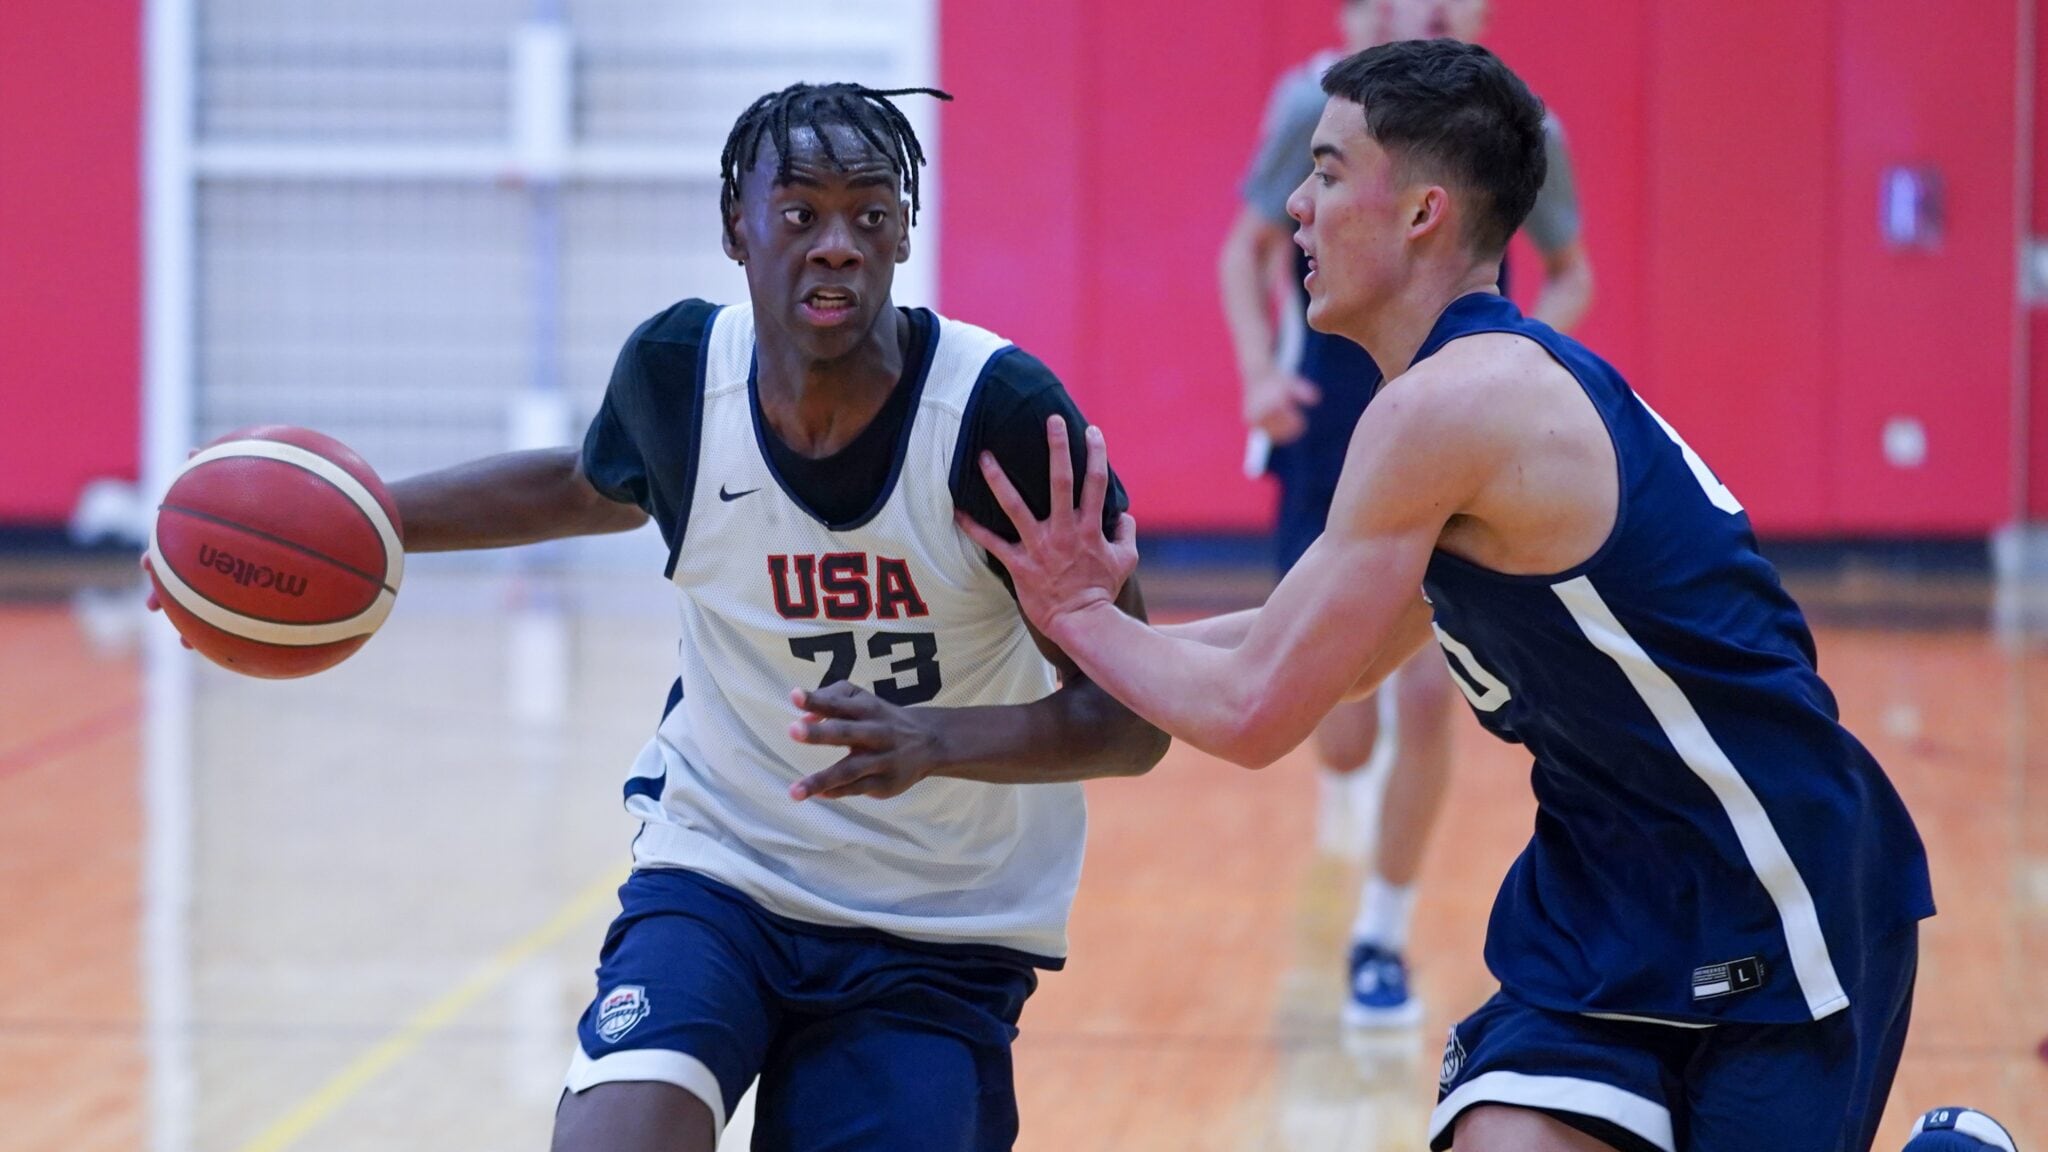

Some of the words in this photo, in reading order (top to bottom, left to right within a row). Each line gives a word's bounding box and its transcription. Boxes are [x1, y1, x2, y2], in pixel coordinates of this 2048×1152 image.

[199, 544, 308, 597] molten
[767, 552, 929, 621] USA
[788, 631, 942, 707] 73
[1737, 968, 1750, 983] L
